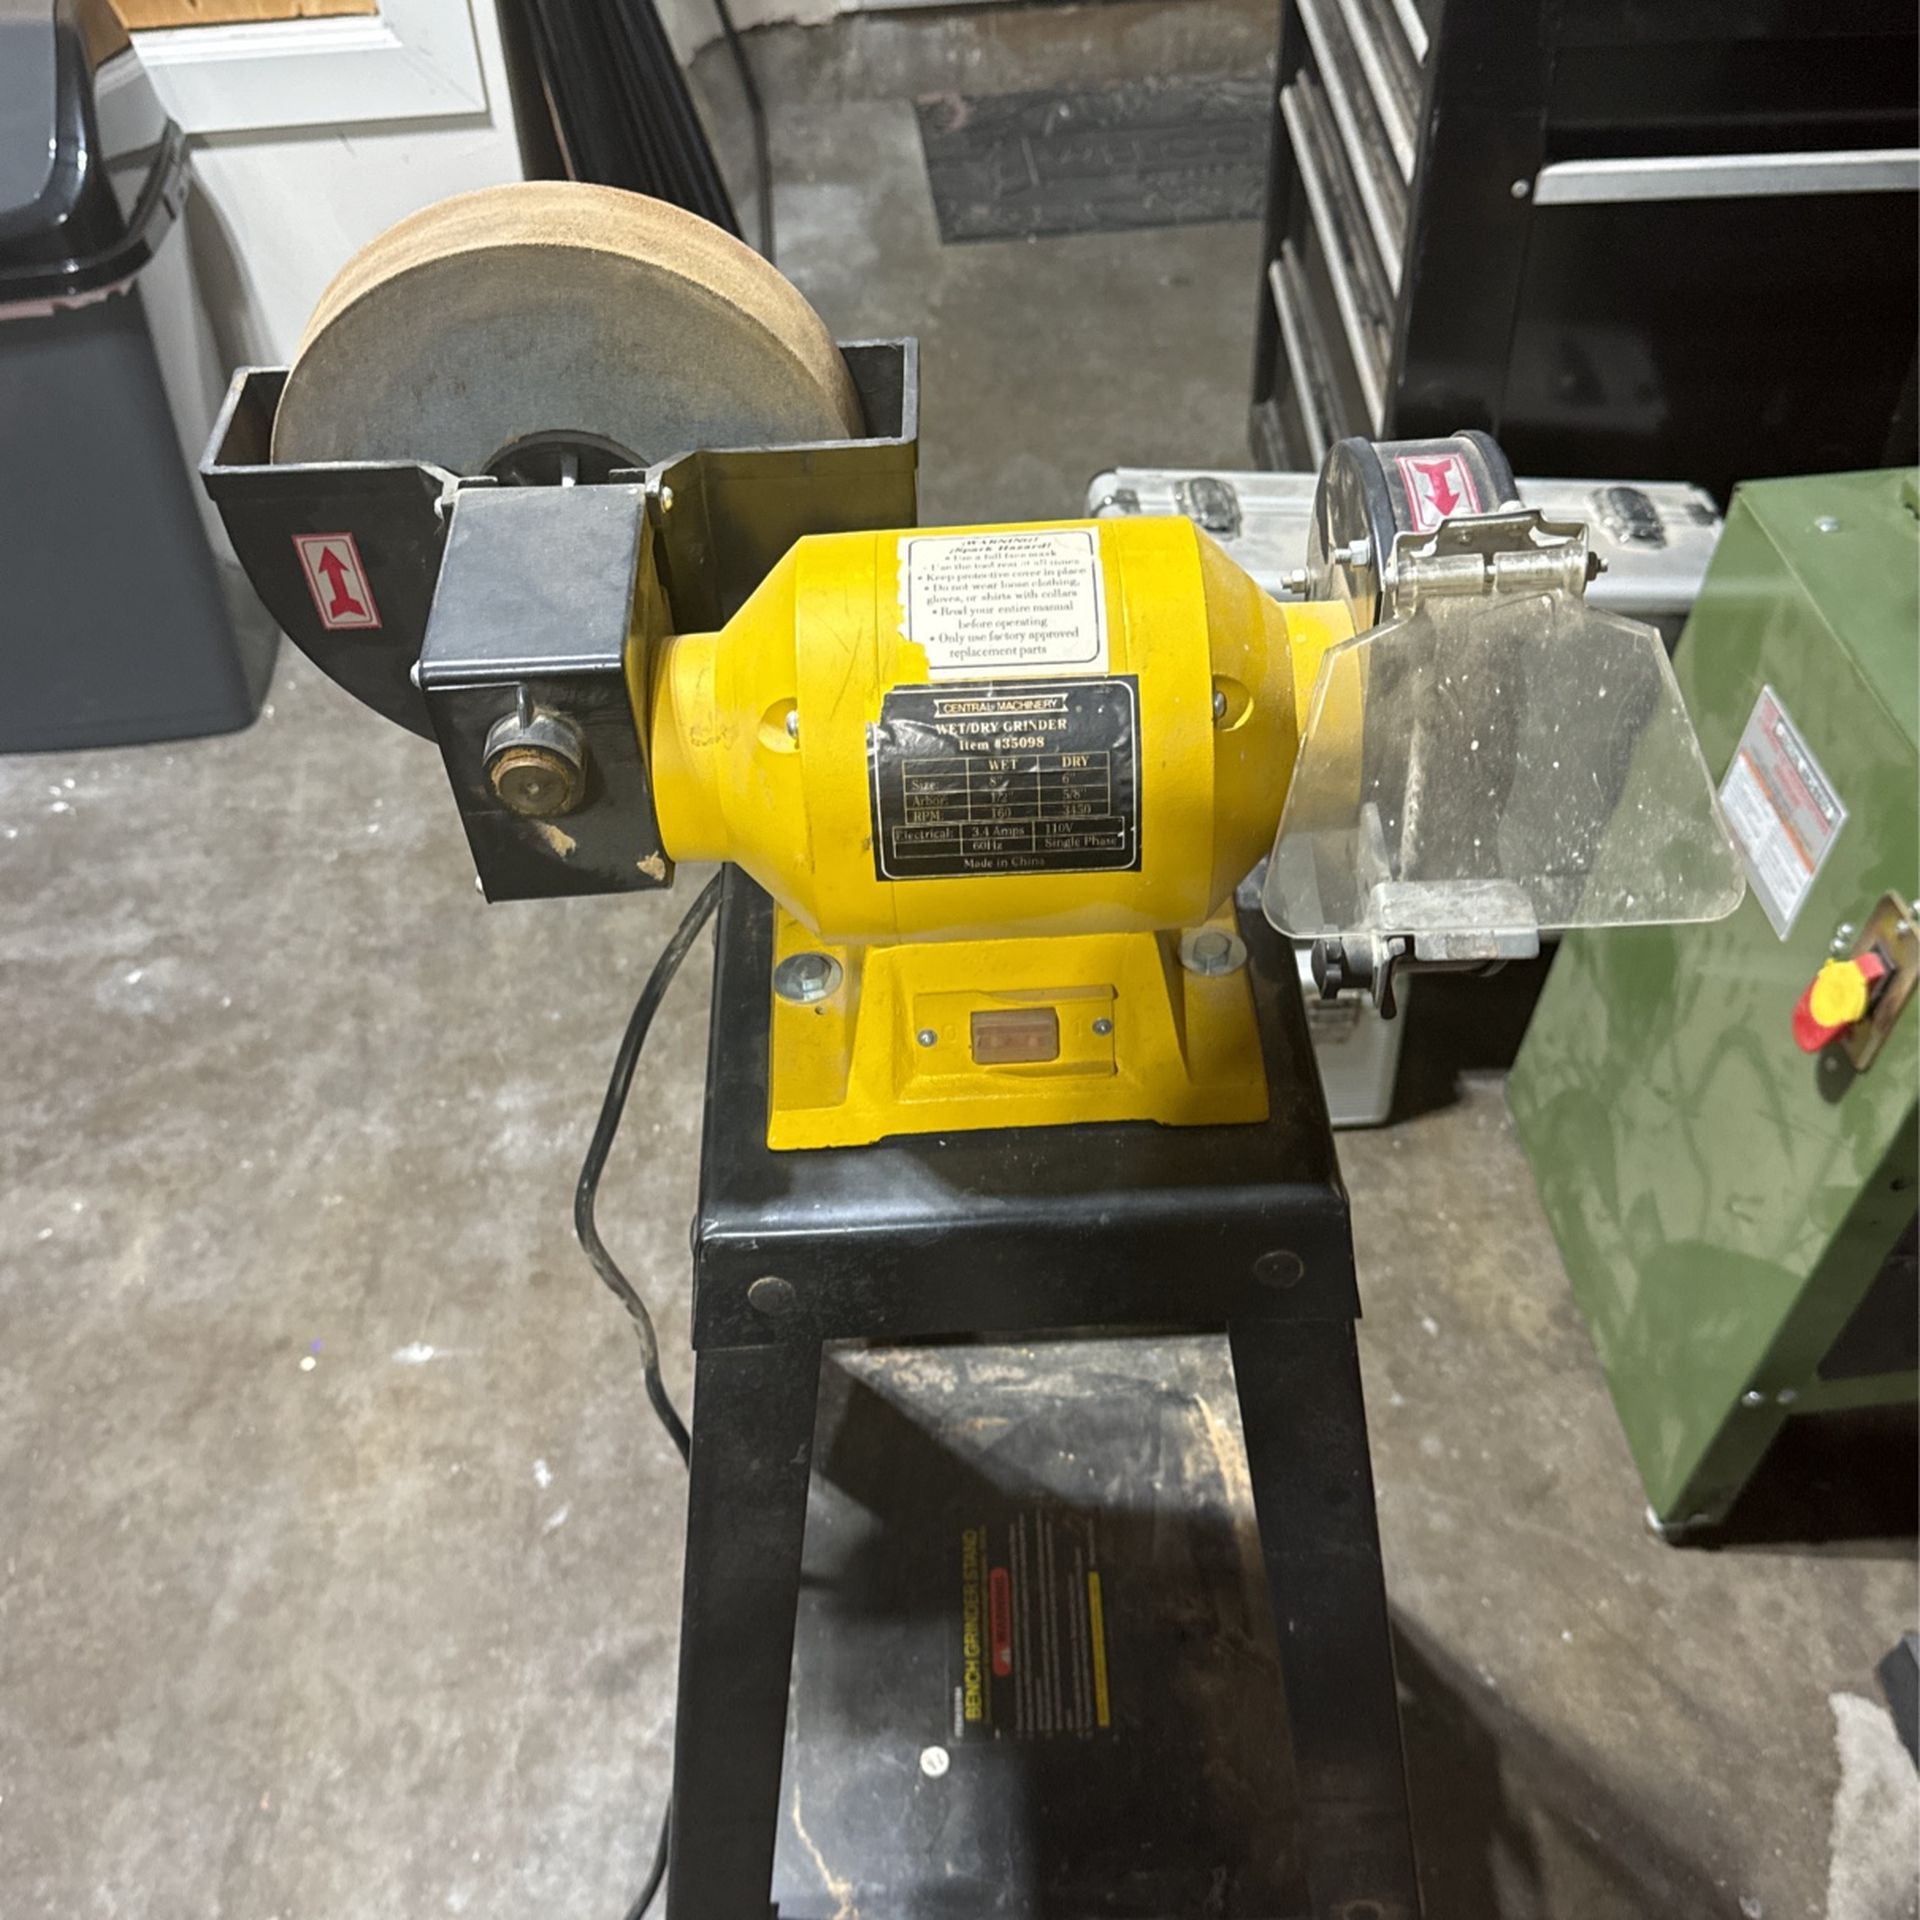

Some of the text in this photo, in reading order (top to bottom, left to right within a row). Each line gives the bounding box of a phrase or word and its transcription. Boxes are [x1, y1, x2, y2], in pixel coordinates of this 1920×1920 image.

[984, 552, 1001, 560] full
[1028, 549, 1056, 558] mask
[926, 566, 1087, 583] Keep protective cover in place
[933, 577, 1081, 592] Do not wear loose clothing,
[926, 593, 964, 606] gloves,
[981, 591, 1012, 601] shirts
[1016, 588, 1038, 600] with
[1041, 587, 1078, 599] collars
[941, 599, 1074, 618] Read your entire manual
[958, 614, 1049, 630] before operating
[939, 626, 1079, 646] Only use factory approved
[949, 645, 1047, 661] replacement parts
[942, 699, 1058, 714] CENTRAL MACHINERY
[935, 718, 1068, 735] WET/DRY GRINDER
[959, 736, 1045, 751] Item #35098
[988, 755, 1090, 771] WET DRY
[991, 807, 1012, 820] 160
[992, 824, 1025, 839] Amps
[1045, 822, 1073, 834] 110V
[972, 834, 1117, 851] 60Hz Single Phase
[963, 855, 1045, 869] Made in China
[962, 1530, 982, 1721] BENCH GRINDER STAND
